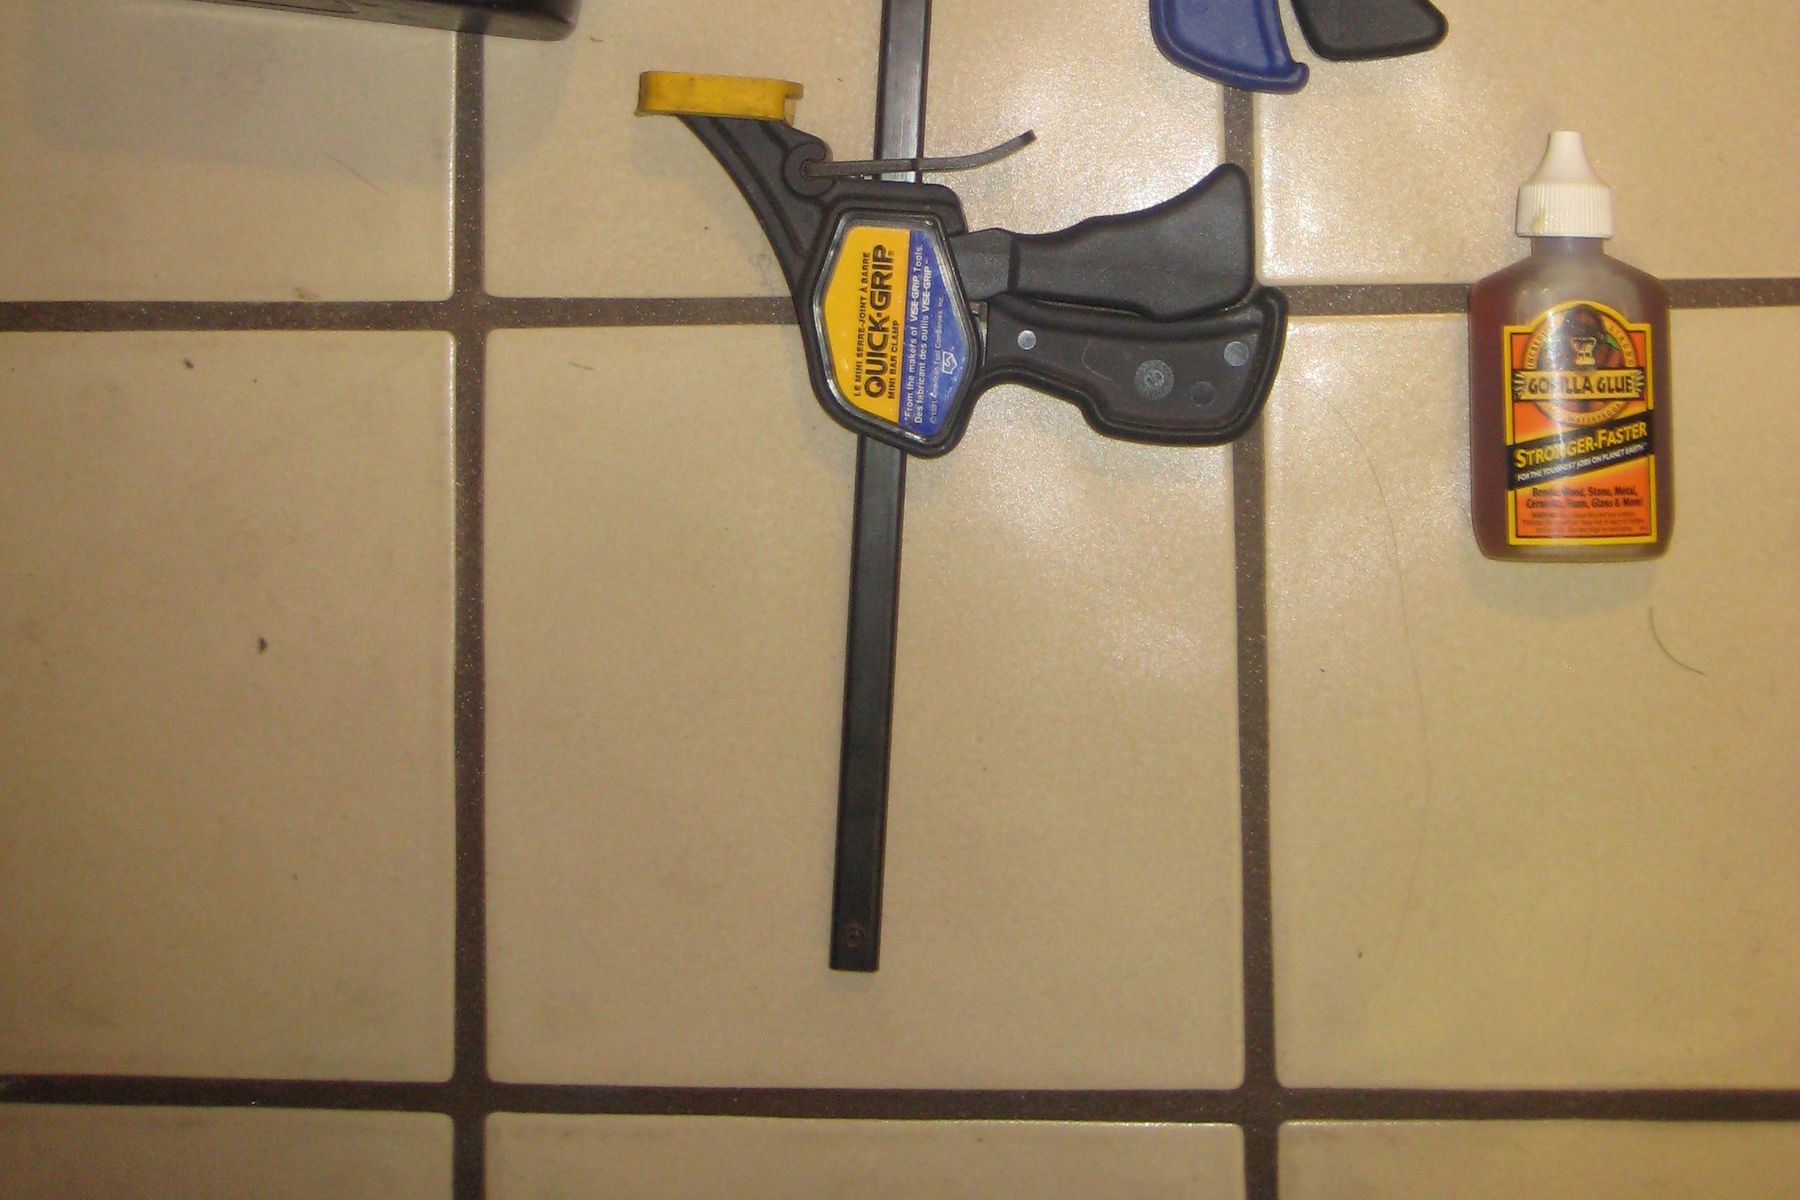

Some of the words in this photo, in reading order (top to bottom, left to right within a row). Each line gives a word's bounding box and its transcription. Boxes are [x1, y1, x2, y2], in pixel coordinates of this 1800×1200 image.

[861, 252, 870, 284] BARRE
[913, 244, 923, 272] Tools.
[910, 276, 920, 322] VISE-GRIP
[921, 265, 931, 312] VISE-GRIP
[856, 296, 867, 359] SERRE-JOINT
[890, 320, 899, 353] CLAMP
[909, 326, 918, 336] of
[919, 315, 929, 341] outils
[918, 343, 927, 360] des
[855, 361, 863, 383] MINI
[889, 355, 898, 375] BAR
[854, 384, 862, 397] LE
[888, 378, 896, 399] MINI
[906, 375, 915, 390] the
[915, 362, 926, 403] fabricant
[1528, 376, 1594, 395] GOILLA
[1596, 375, 1633, 393] GLUE
[914, 406, 924, 423] Des
[1517, 473, 1530, 482] FOR
[1530, 469, 1542, 478] THE
[1591, 455, 1601, 464] ON
[1601, 447, 1625, 462] PLANET
